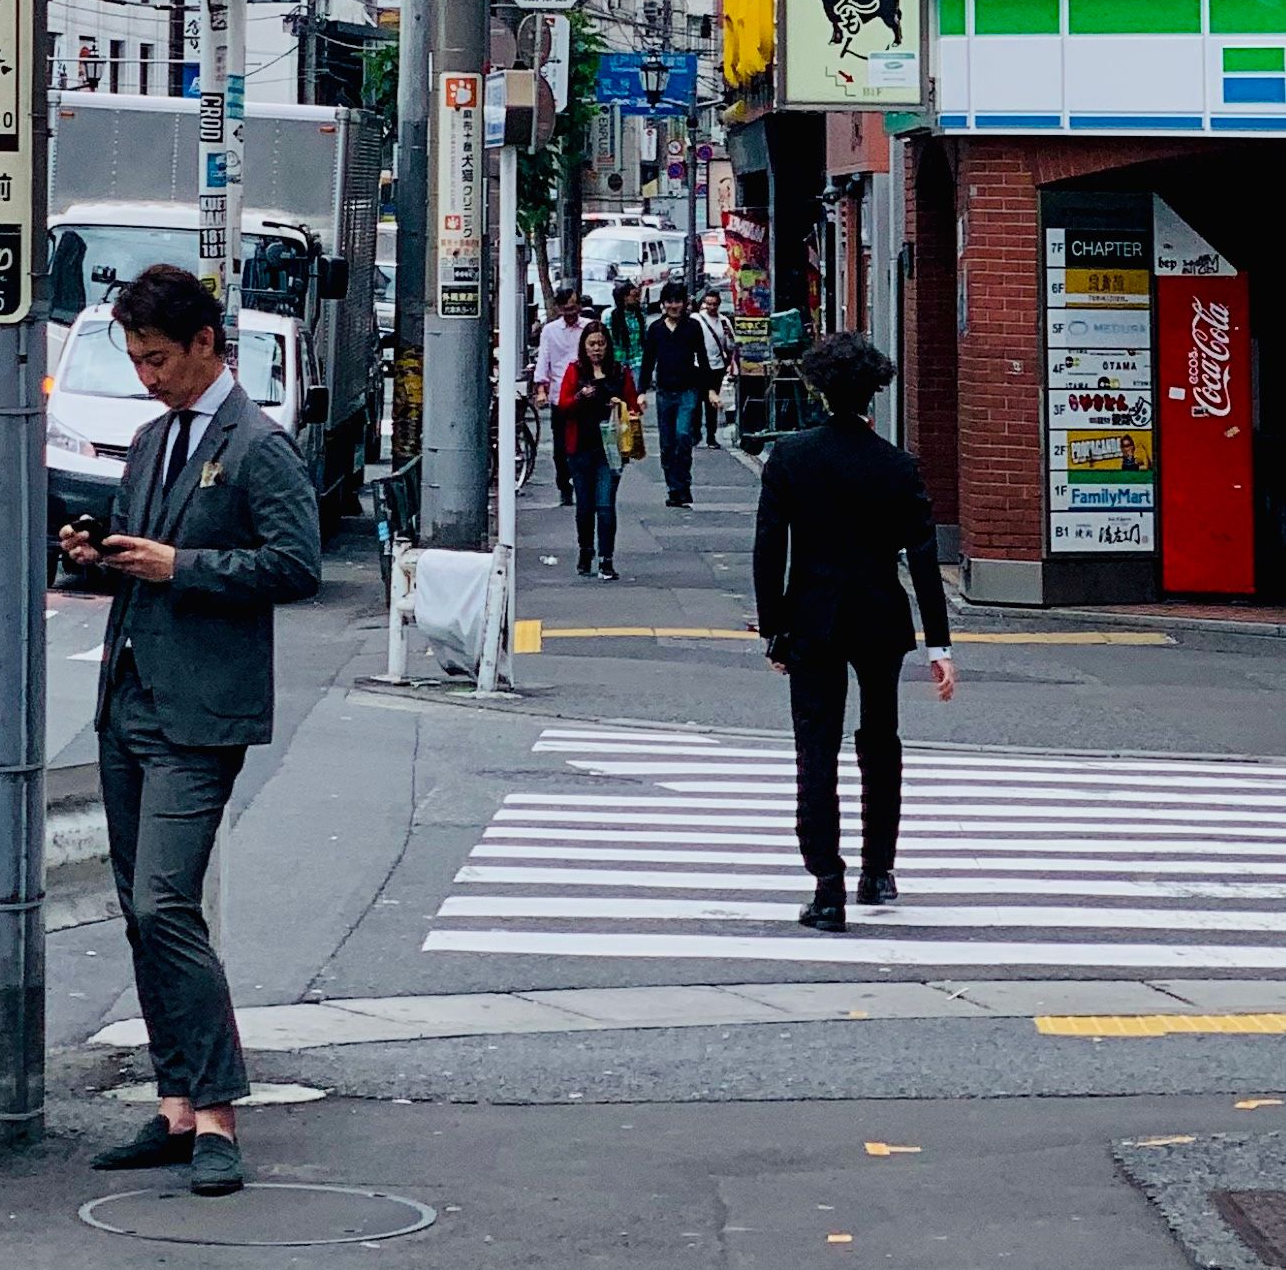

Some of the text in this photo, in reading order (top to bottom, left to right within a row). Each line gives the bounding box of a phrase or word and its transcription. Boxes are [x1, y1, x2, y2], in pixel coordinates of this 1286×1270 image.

[1051, 240, 1143, 257] 7F CHAPTER
[1051, 283, 1064, 294] 6F
[1052, 324, 1064, 334] 5F
[1191, 294, 1232, 417] Coca-Cola
[1052, 360, 1138, 374] 4F OTAMA
[1053, 404, 1066, 414] 3F
[1054, 445, 1067, 457] 2F
[1054, 485, 1151, 507] 1F FamilyMart
[1055, 526, 1069, 538] B1
